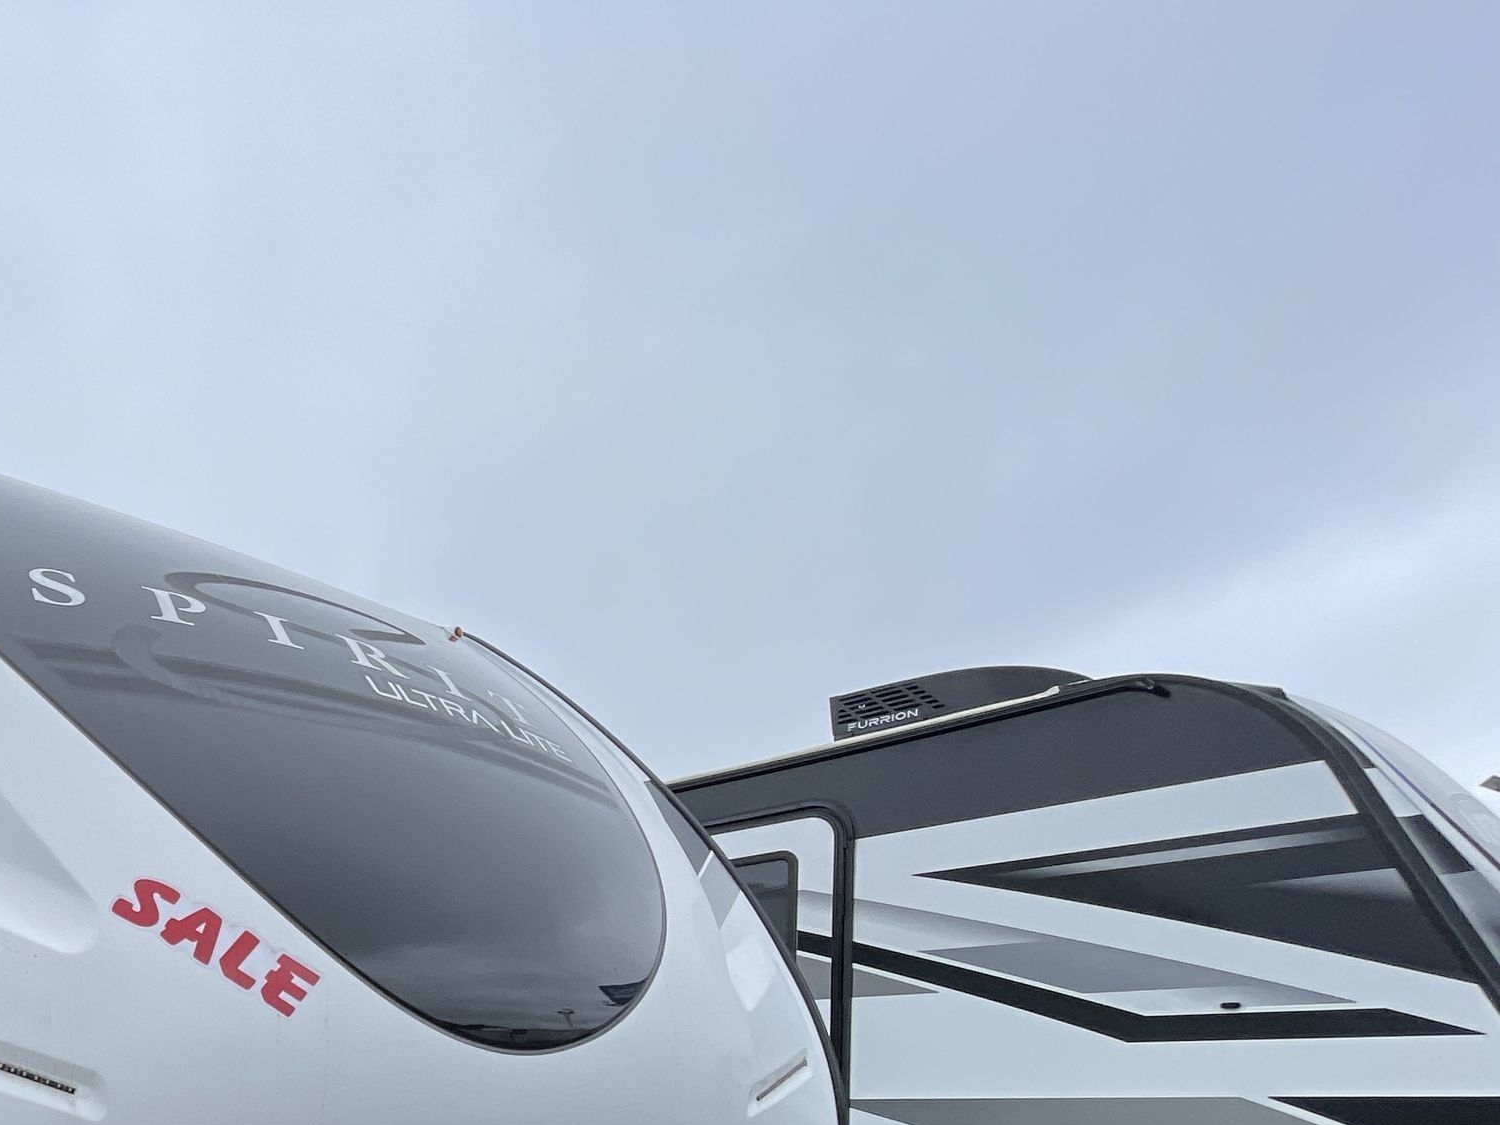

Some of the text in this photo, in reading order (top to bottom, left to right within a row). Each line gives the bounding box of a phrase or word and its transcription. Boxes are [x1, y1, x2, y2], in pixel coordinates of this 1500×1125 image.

[28, 568, 539, 730] SPIRIT
[847, 708, 919, 732] FURRION
[111, 878, 320, 1017] SALE
